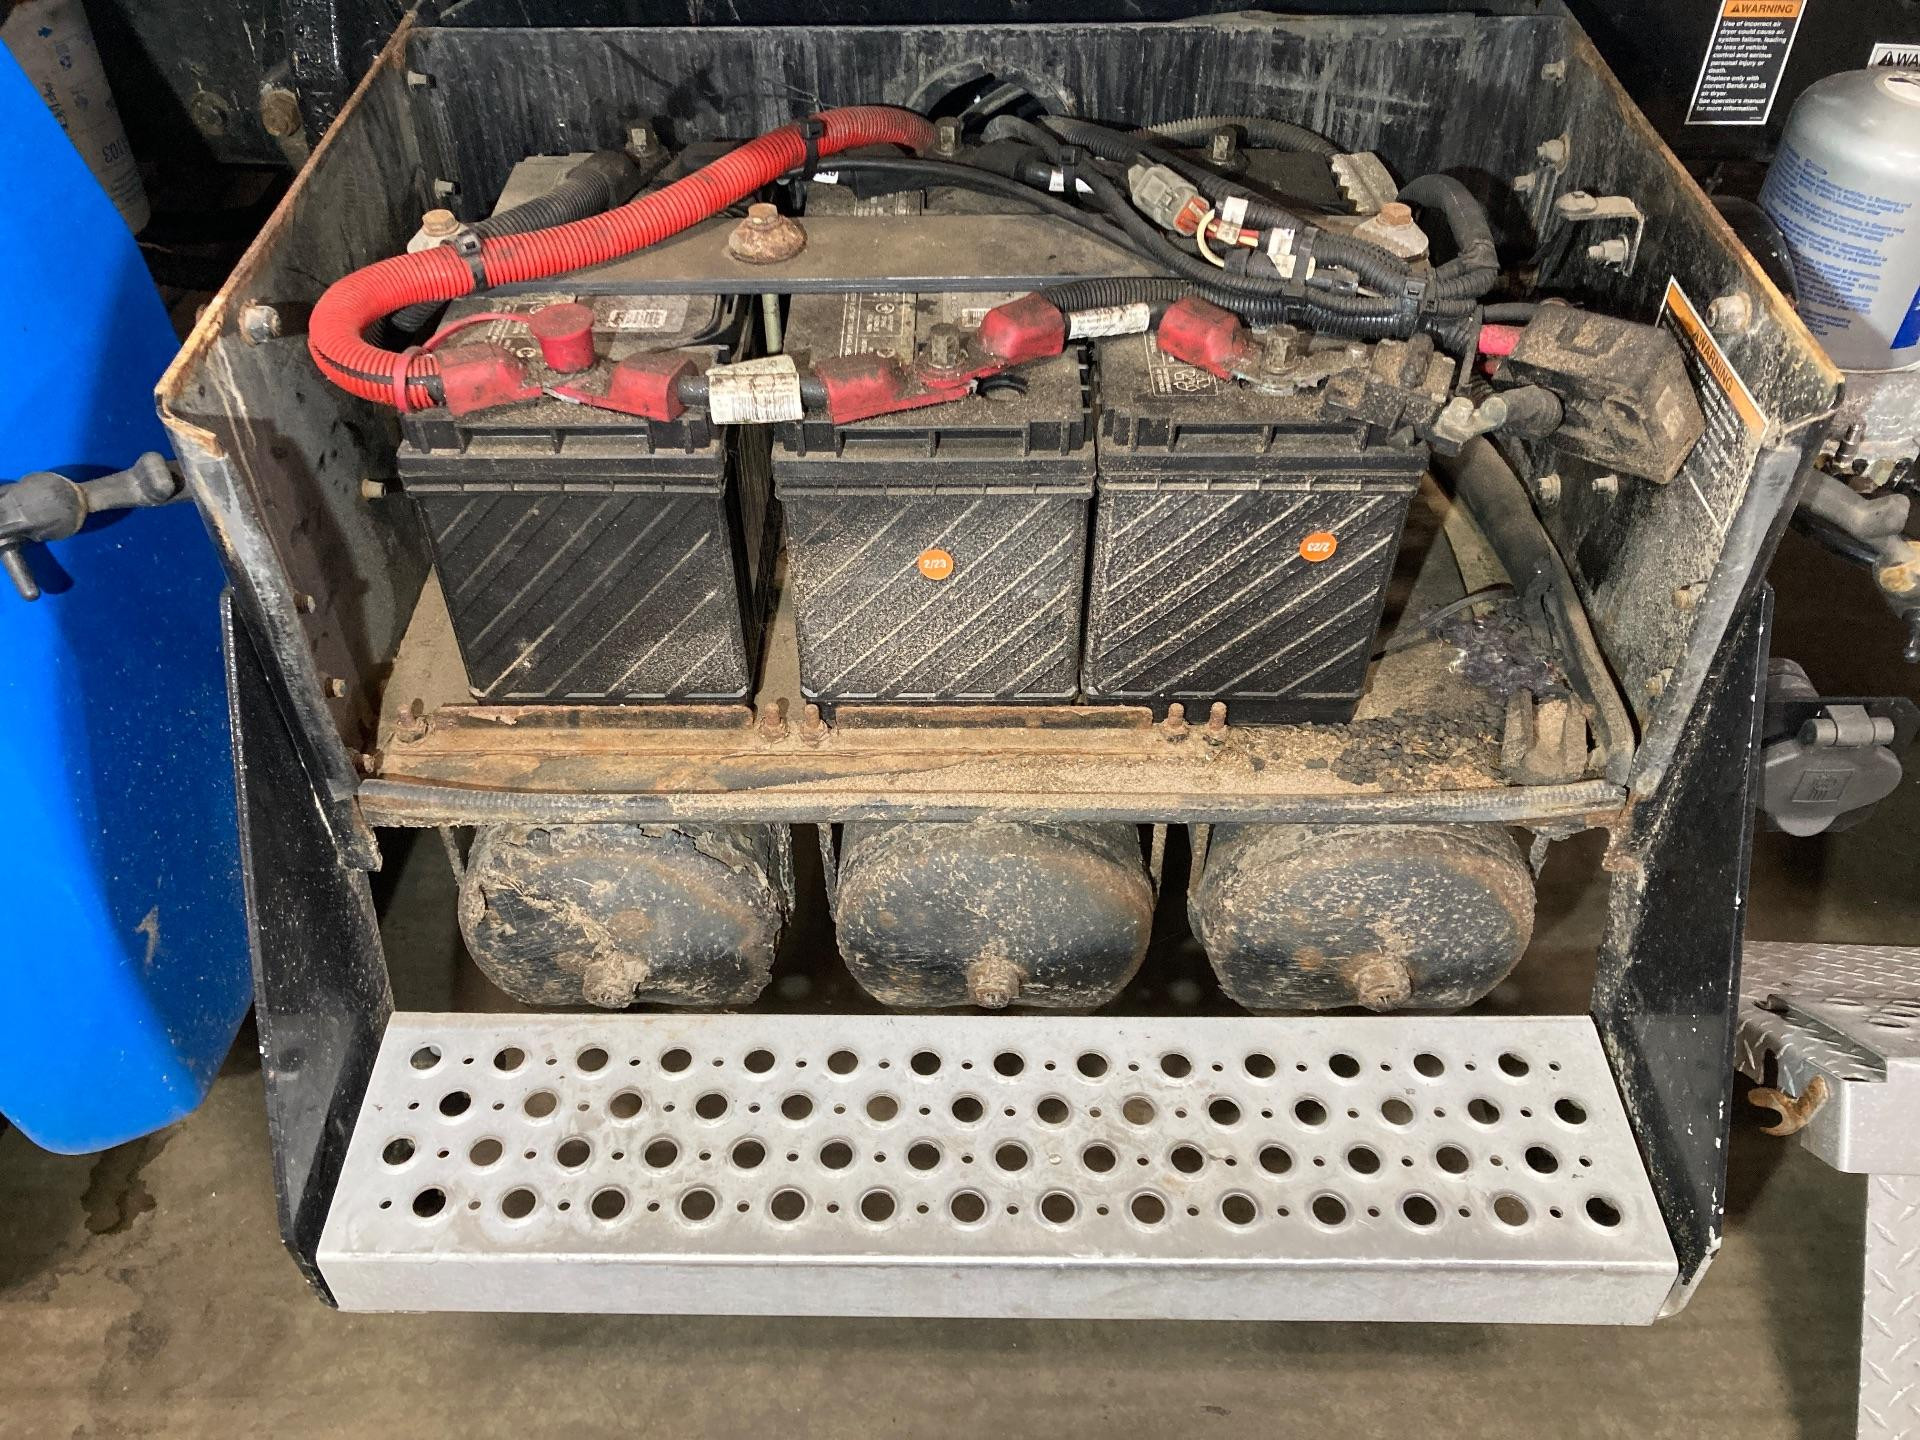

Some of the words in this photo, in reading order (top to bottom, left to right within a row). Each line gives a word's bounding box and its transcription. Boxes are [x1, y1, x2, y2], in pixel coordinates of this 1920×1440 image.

[1741, 4, 1793, 13] WARNING
[1896, 52, 1920, 67] WA
[1698, 333, 1733, 393] WARNING
[1307, 541, 1330, 552] 2/23
[924, 560, 947, 569] 2/23
